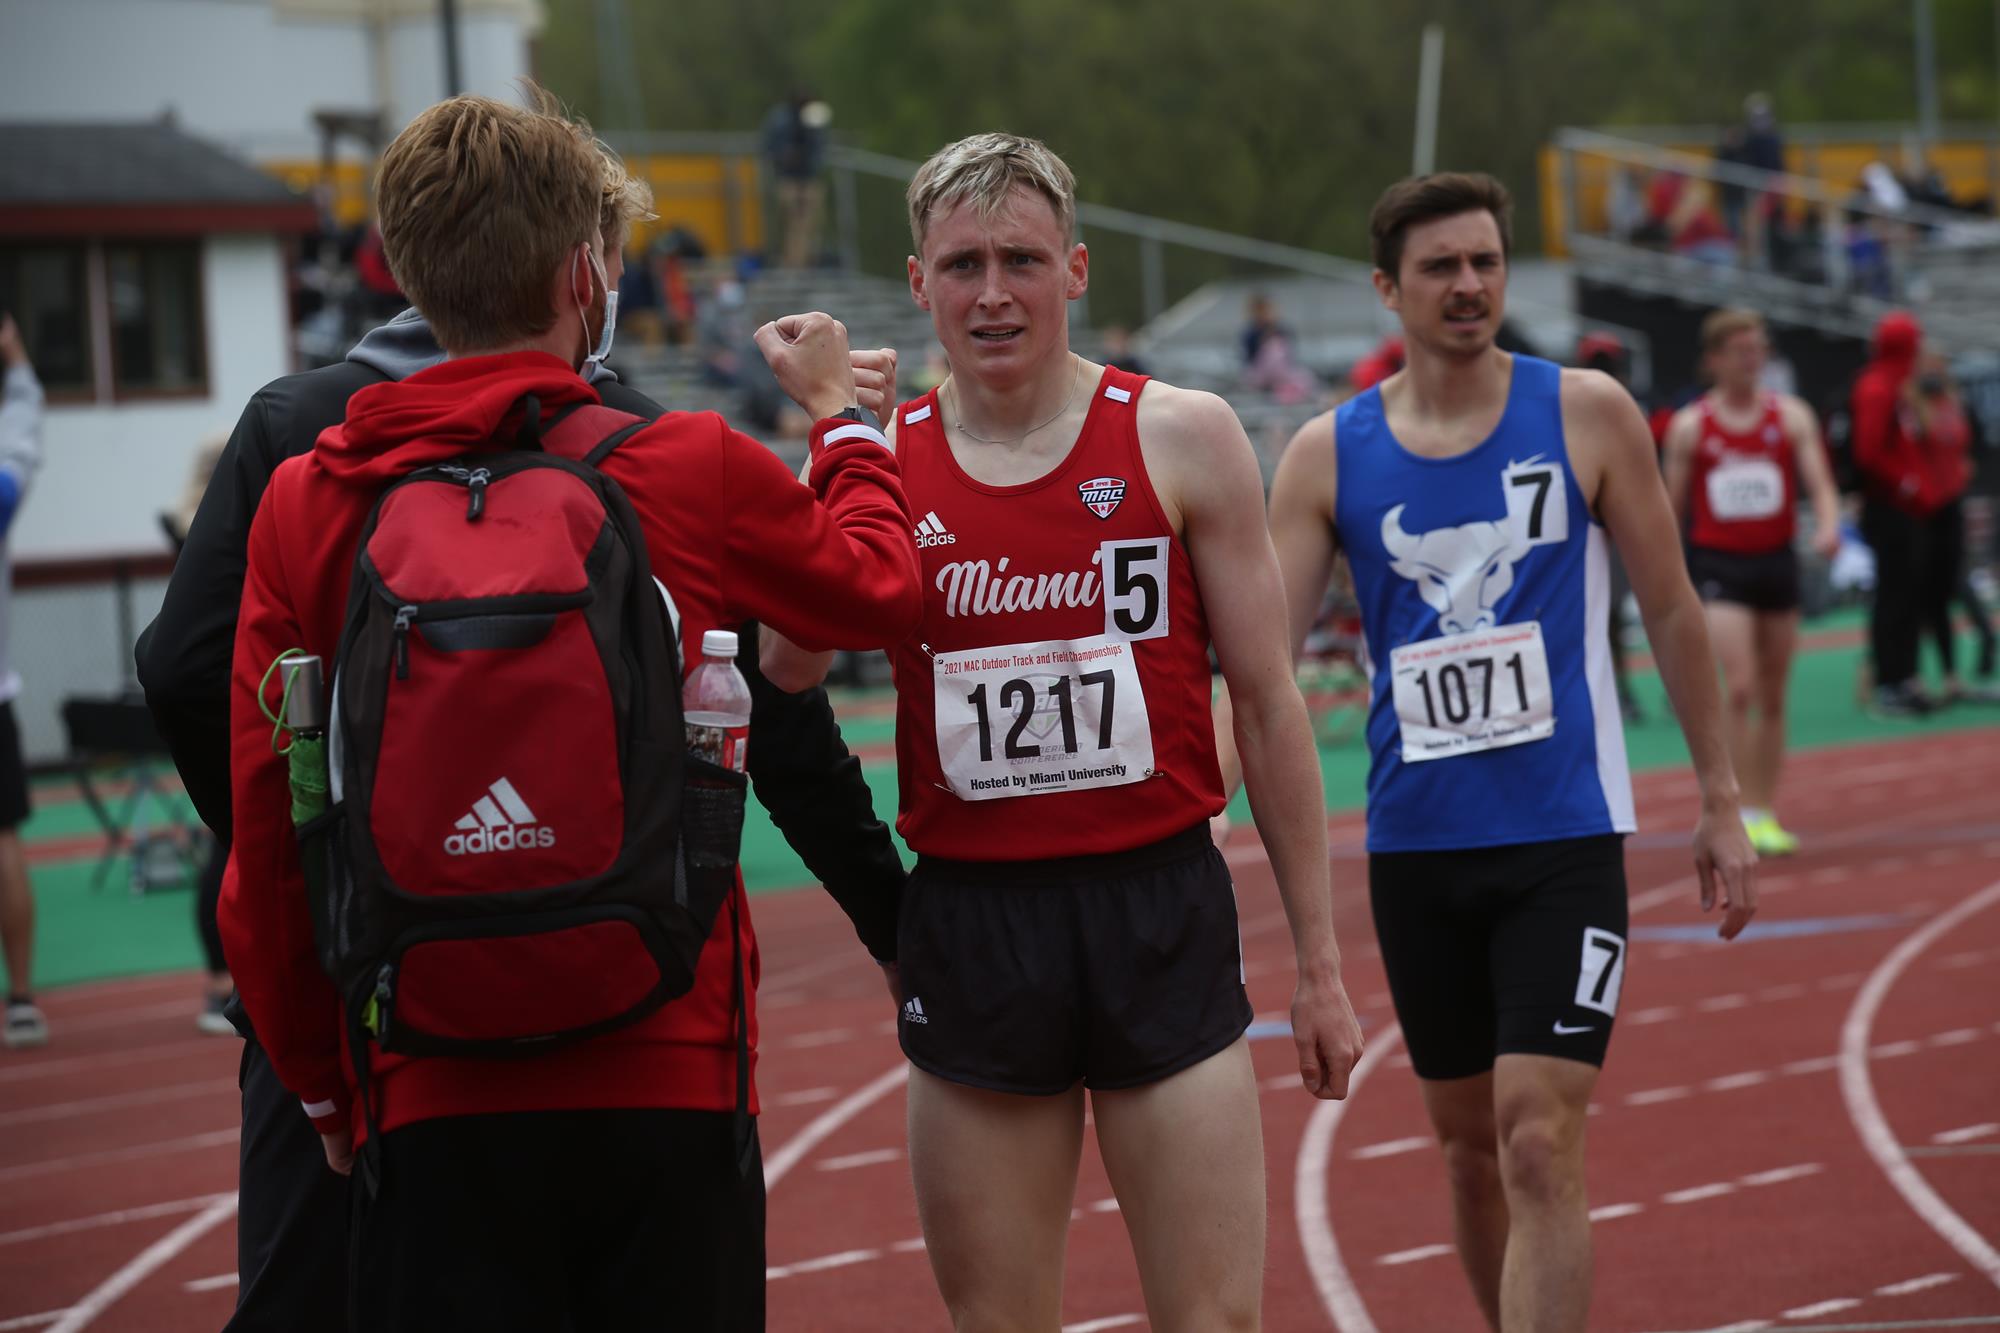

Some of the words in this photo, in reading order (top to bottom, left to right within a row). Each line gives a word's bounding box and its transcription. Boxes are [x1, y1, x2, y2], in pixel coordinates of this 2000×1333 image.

[1082, 489, 1124, 503] MAC
[1510, 471, 1553, 539] 7
[916, 533, 956, 549] didas
[935, 550, 1102, 618] Miami
[1113, 544, 1160, 635] 5
[944, 662, 962, 675] 2021
[964, 659, 980, 672] MAC
[982, 657, 1010, 671] Outdoor
[1013, 654, 1034, 667] Track
[1036, 653, 1051, 665] and
[1069, 644, 1123, 662] Championships
[1415, 652, 1529, 728] 1071
[967, 669, 1116, 762] 1217
[970, 776, 1009, 791] Hosted
[1013, 774, 1027, 788] by
[1029, 770, 1066, 785] Miami
[1068, 764, 1127, 781] University
[444, 824, 556, 856] adidas
[1590, 935, 1621, 1005] 7
